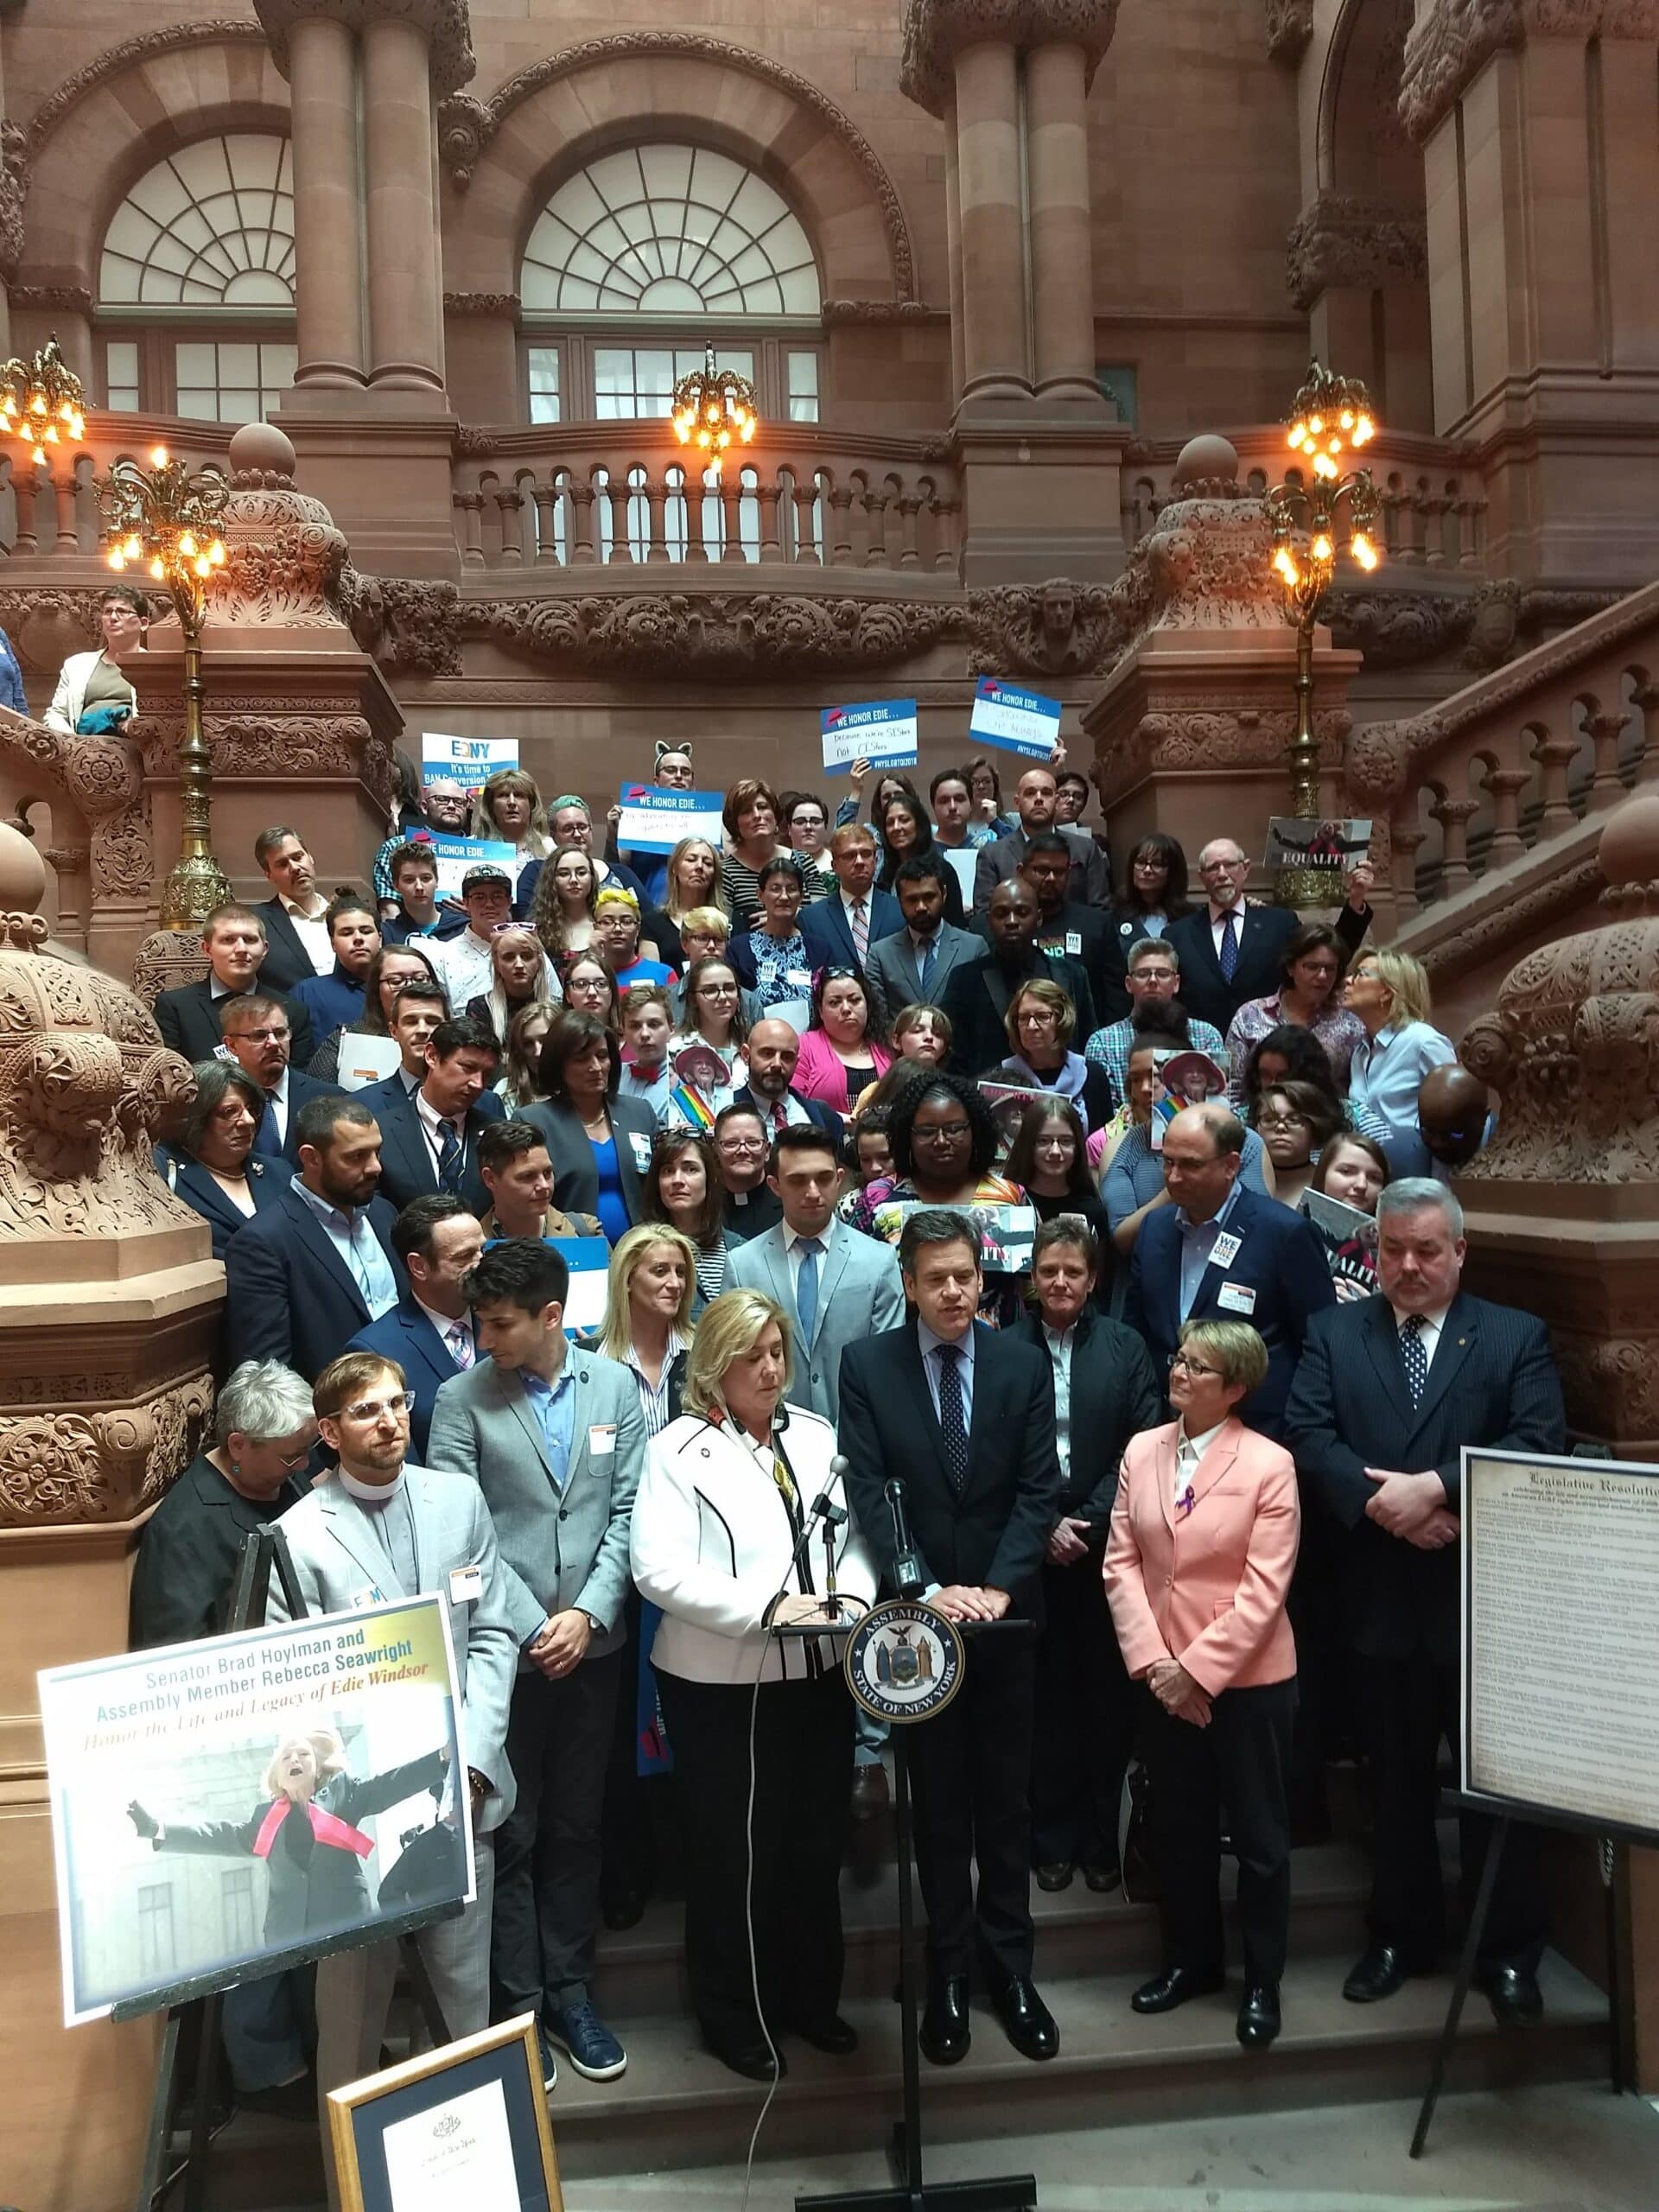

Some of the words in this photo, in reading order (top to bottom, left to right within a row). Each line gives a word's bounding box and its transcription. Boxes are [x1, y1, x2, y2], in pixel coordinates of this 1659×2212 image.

[992, 690, 1001, 702] WE
[1002, 692, 1024, 706] HONOR
[837, 715, 848, 728] WE
[849, 711, 872, 727] HONOR
[451, 763, 463, 774] It's
[464, 764, 481, 775] time
[483, 765, 491, 773] to
[639, 796, 651, 806] WE
[652, 797, 677, 809] HONOR
[438, 843, 466, 856] HONOR
[1282, 852, 1346, 867] EQUALITY
[1219, 1235, 1238, 1249] WE
[1529, 1471, 1594, 1491] Legislative
[1599, 1478, 1659, 1497] Resolutio
[865, 1608, 940, 1637] ASSEMBLY
[146, 1665, 211, 1689] Senator
[219, 1652, 255, 1675] Brad
[261, 1639, 331, 1665] Hoylman
[337, 1629, 365, 1649] and
[96, 1694, 181, 1723] Assembly
[188, 1677, 256, 1702] Member
[263, 1661, 330, 1687] Rebecca
[335, 1640, 412, 1671] Seawright
[854, 1669, 883, 1708] STATE
[883, 1702, 902, 1715] OF
[903, 1696, 935, 1715] NEW
[934, 1661, 957, 1699] YORK
[145, 1722, 168, 1738] the
[214, 1700, 245, 1722] and
[251, 1691, 305, 1714] Legacy
[310, 1683, 327, 1703] of
[331, 1677, 365, 1696] Edie
[368, 1662, 429, 1687] Windsor
